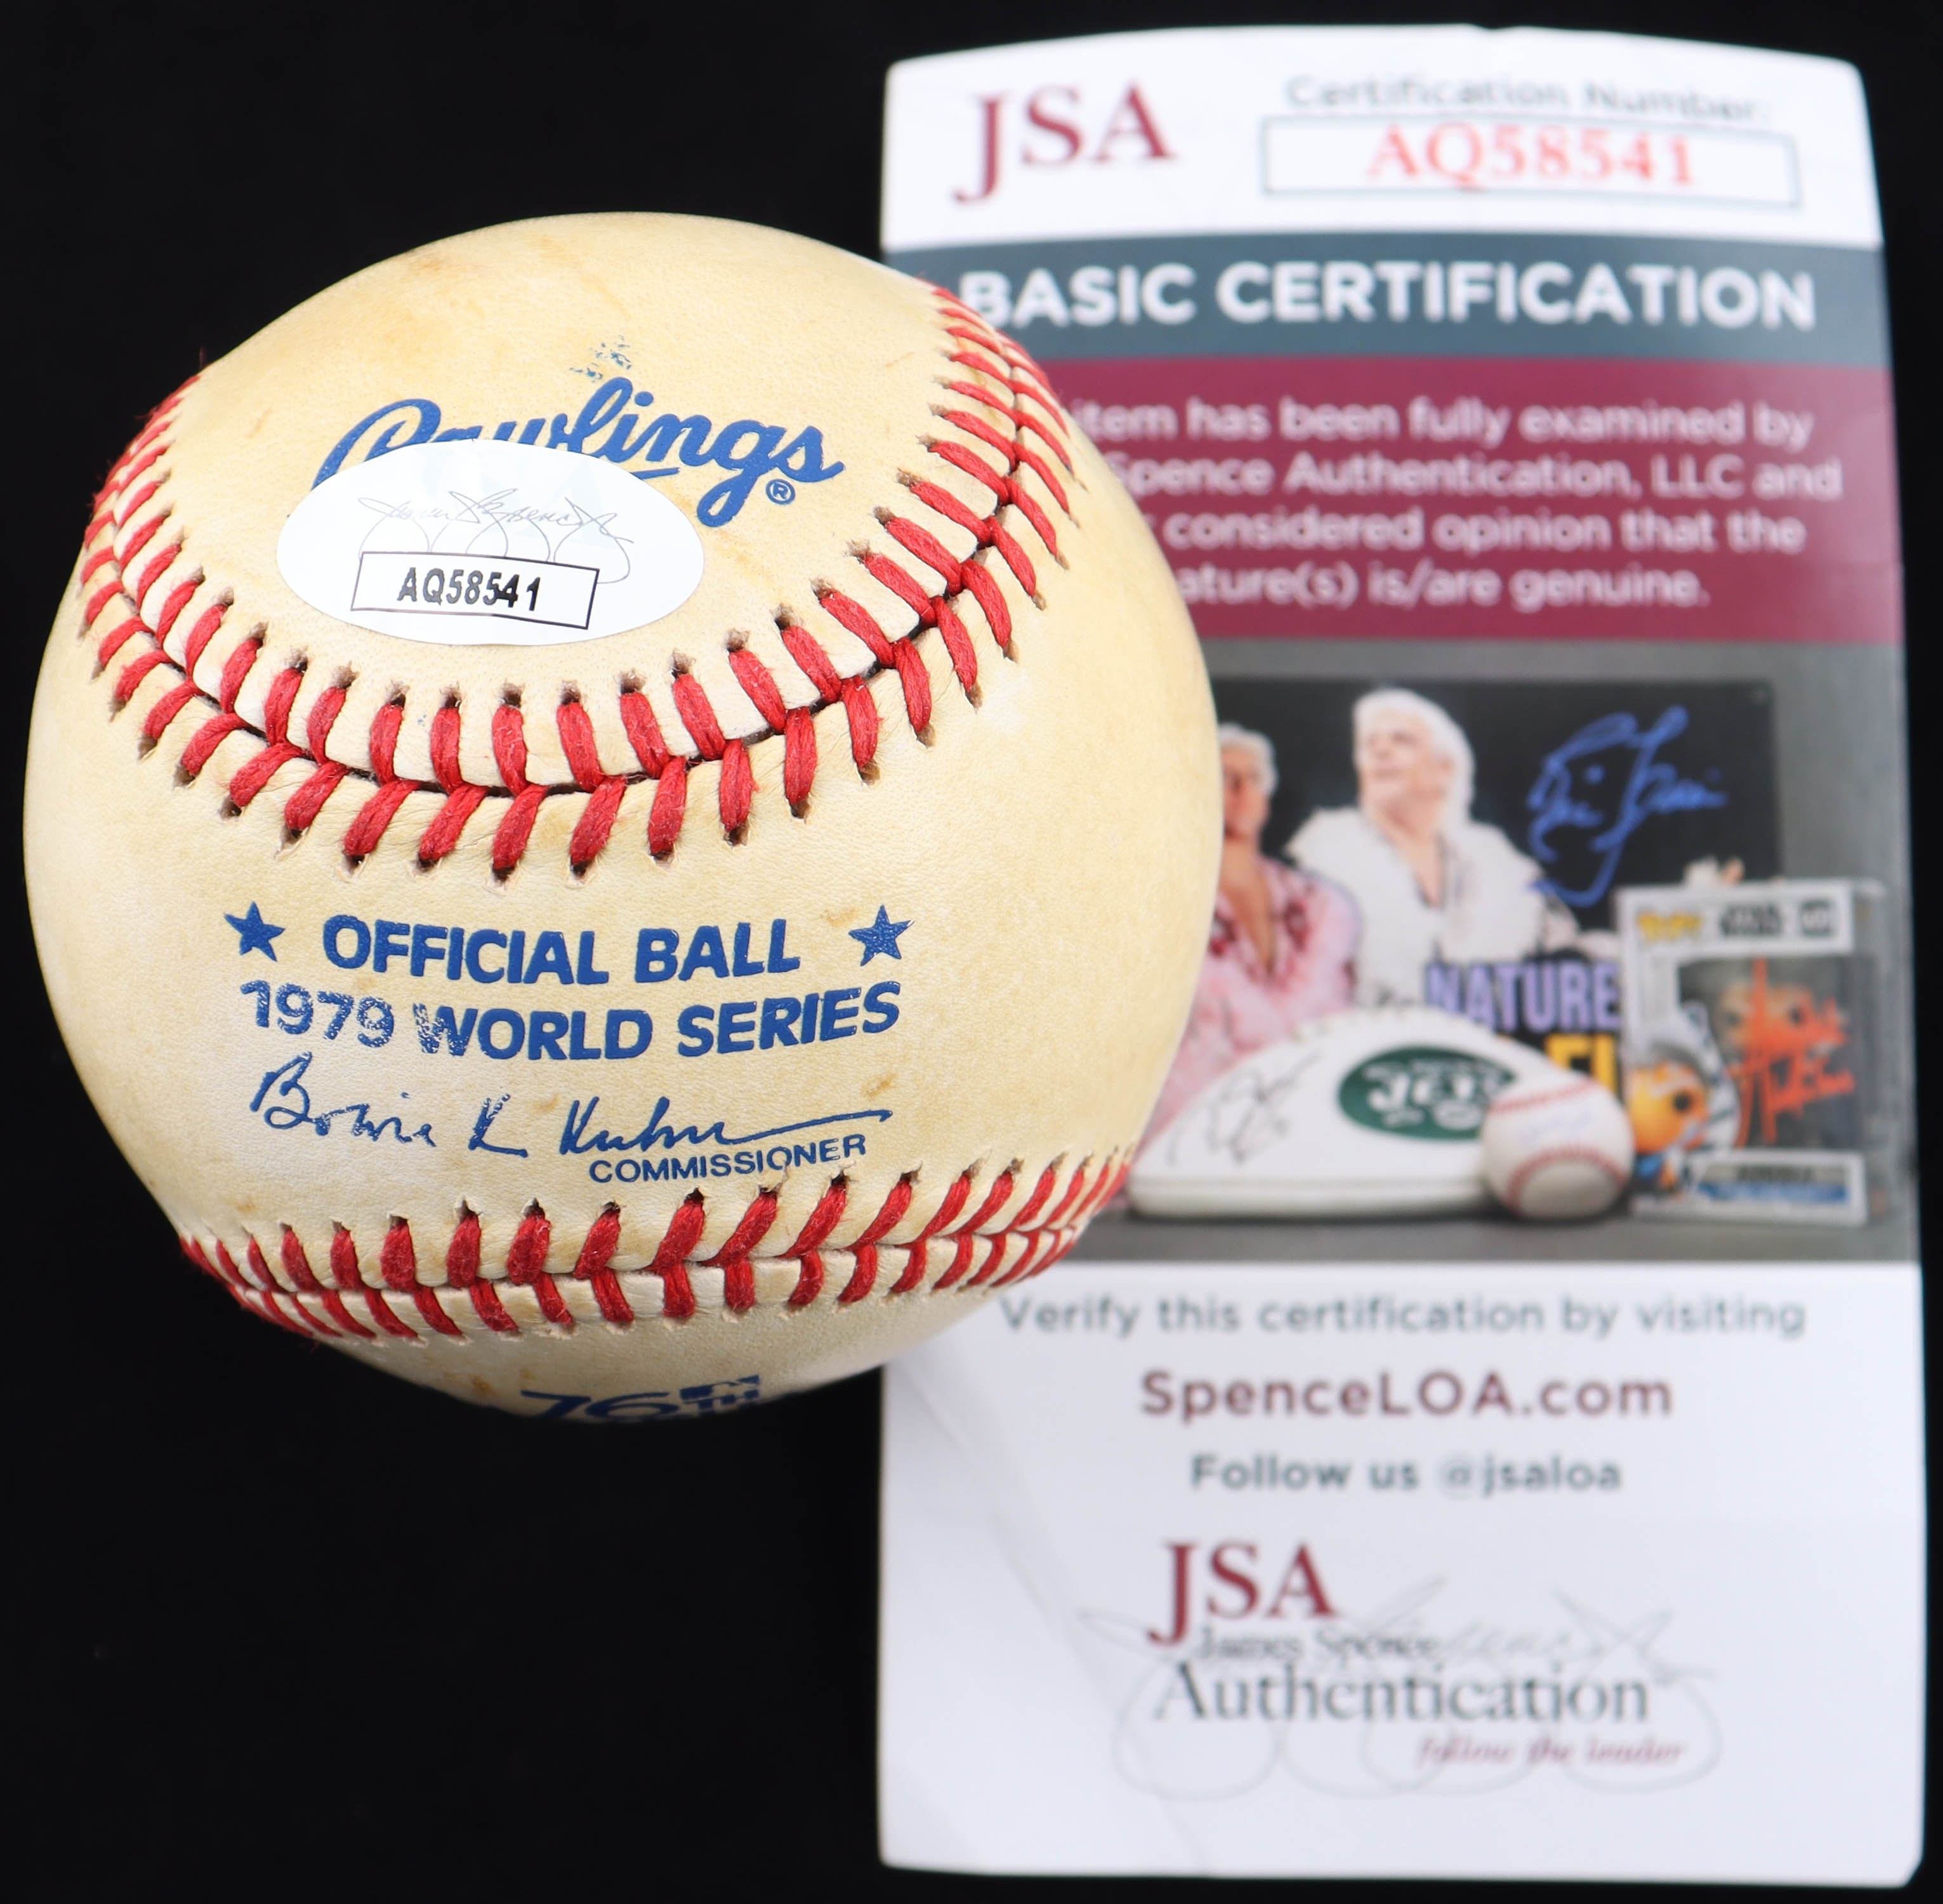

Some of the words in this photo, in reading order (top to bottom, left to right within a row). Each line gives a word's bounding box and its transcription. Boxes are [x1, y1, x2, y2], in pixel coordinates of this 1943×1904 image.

[1285, 74, 1570, 113] Certification
[1586, 83, 1770, 122] Number:
[952, 79, 1179, 203] JSA
[1366, 124, 1698, 192] AQ58541
[959, 261, 1195, 327] BASIC
[1217, 260, 1816, 331] CERTIFICATION
[1185, 395, 1270, 442] has
[1279, 396, 1400, 442] been
[1406, 396, 1510, 449] fully
[1518, 400, 1746, 447] examined
[1753, 402, 1815, 451] by
[1282, 452, 1642, 501] Authentication,
[1651, 456, 1745, 500] LLC
[1751, 458, 1844, 501] and
[1163, 508, 1424, 551] considered
[1432, 510, 1610, 556] opinion
[1619, 509, 1717, 553] that
[1726, 509, 1807, 555] the
[397, 567, 541, 612] AQ58541
[1367, 559, 1500, 607] is/are
[1510, 565, 1711, 614] genuine.
[322, 914, 609, 985] OFFICIAL
[635, 918, 801, 985] BALL
[240, 979, 395, 1048] 1979
[414, 1003, 654, 1061] WORLD
[676, 980, 902, 1057] SERIES
[1426, 958, 1622, 1033] NATURE
[589, 1134, 867, 1184] COMMISSIONER
[999, 1296, 1137, 1338] Verify
[1157, 1296, 1242, 1334] this
[1258, 1296, 1545, 1335] certification
[1561, 1296, 1622, 1339] by
[1637, 1296, 1806, 1340] visiting
[1141, 1367, 1674, 1423] SpenceLOA.com
[1189, 1453, 1350, 1493] Follow
[1369, 1464, 1421, 1493] us
[1146, 1541, 1335, 1649] JSA
[1152, 1660, 1650, 1724] Authentication
